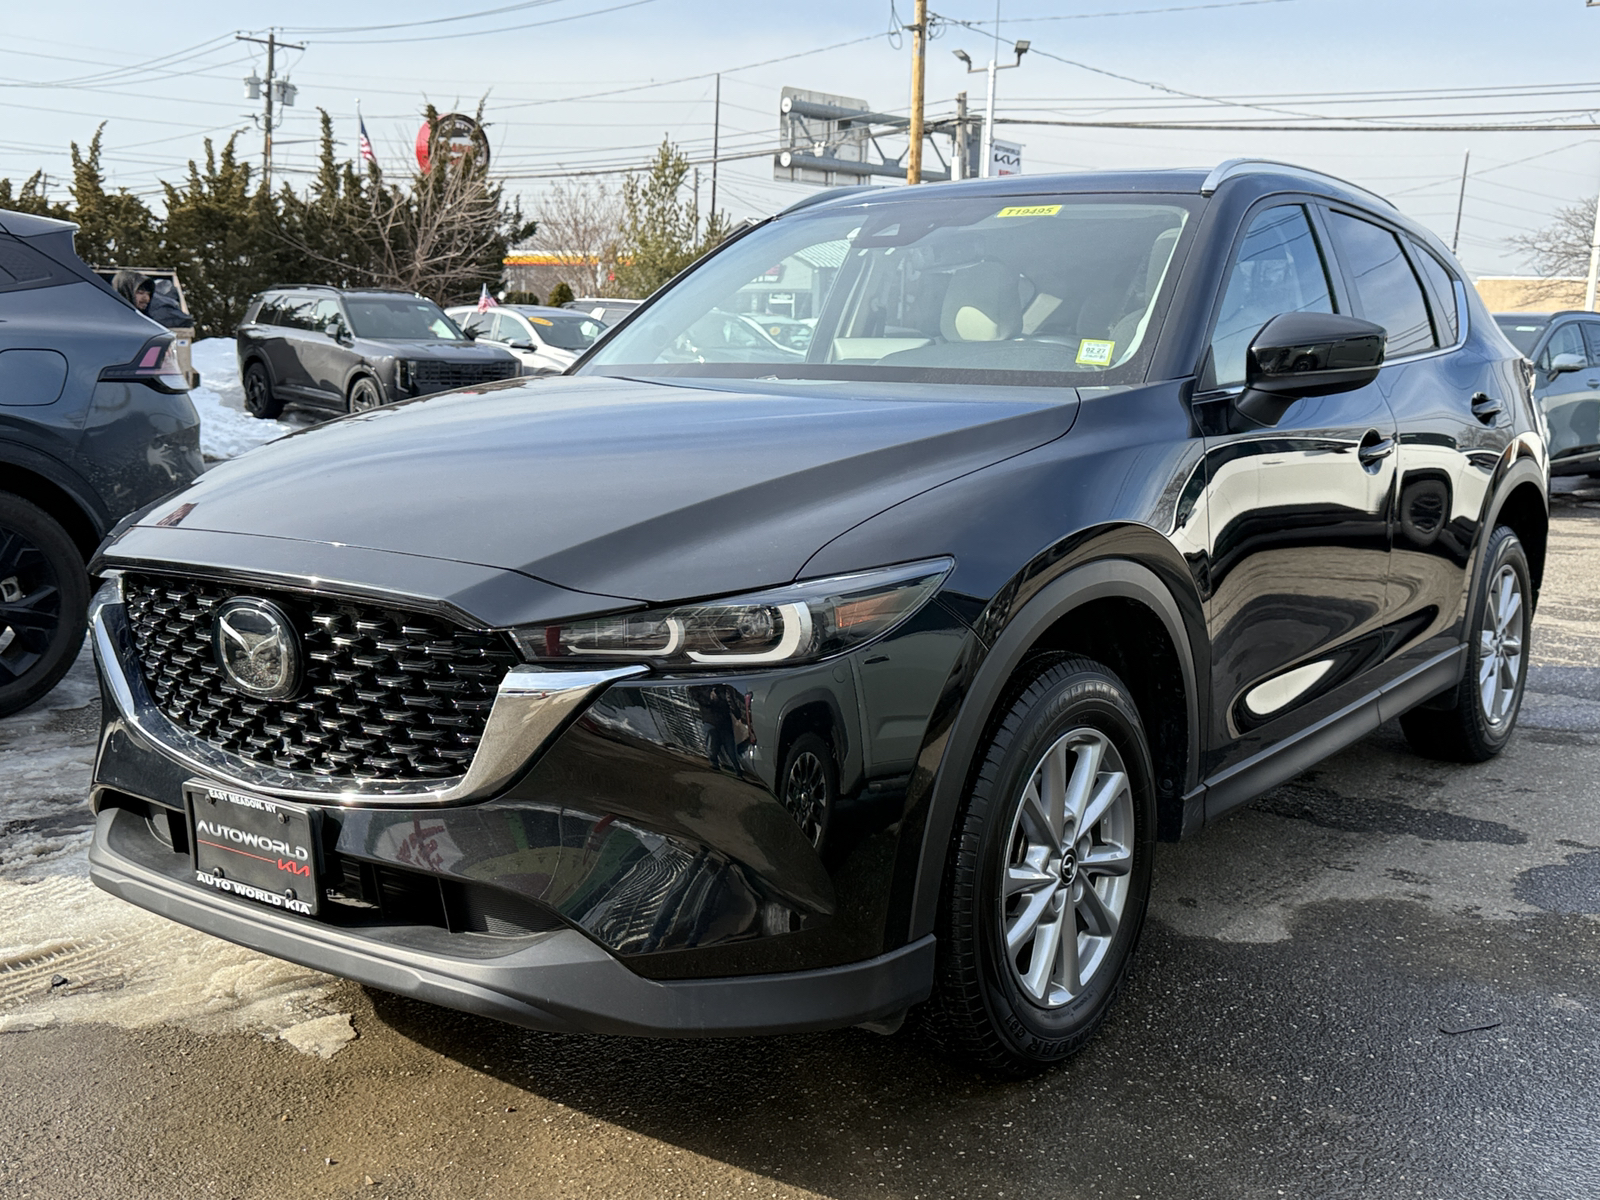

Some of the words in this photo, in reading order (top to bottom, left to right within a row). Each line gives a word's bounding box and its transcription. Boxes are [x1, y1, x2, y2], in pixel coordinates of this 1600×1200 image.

[994, 153, 1020, 167] KIA
[1006, 207, 1055, 216] T19495
[1021, 682, 1120, 754] YOKOHAMA
[208, 789, 229, 802] EAST
[264, 801, 277, 814] NY
[196, 819, 309, 861] AUTOWORLD
[277, 858, 310, 877] KIA
[196, 872, 231, 891] AUTO
[233, 882, 282, 906] WORLD
[285, 899, 311, 915] KIA
